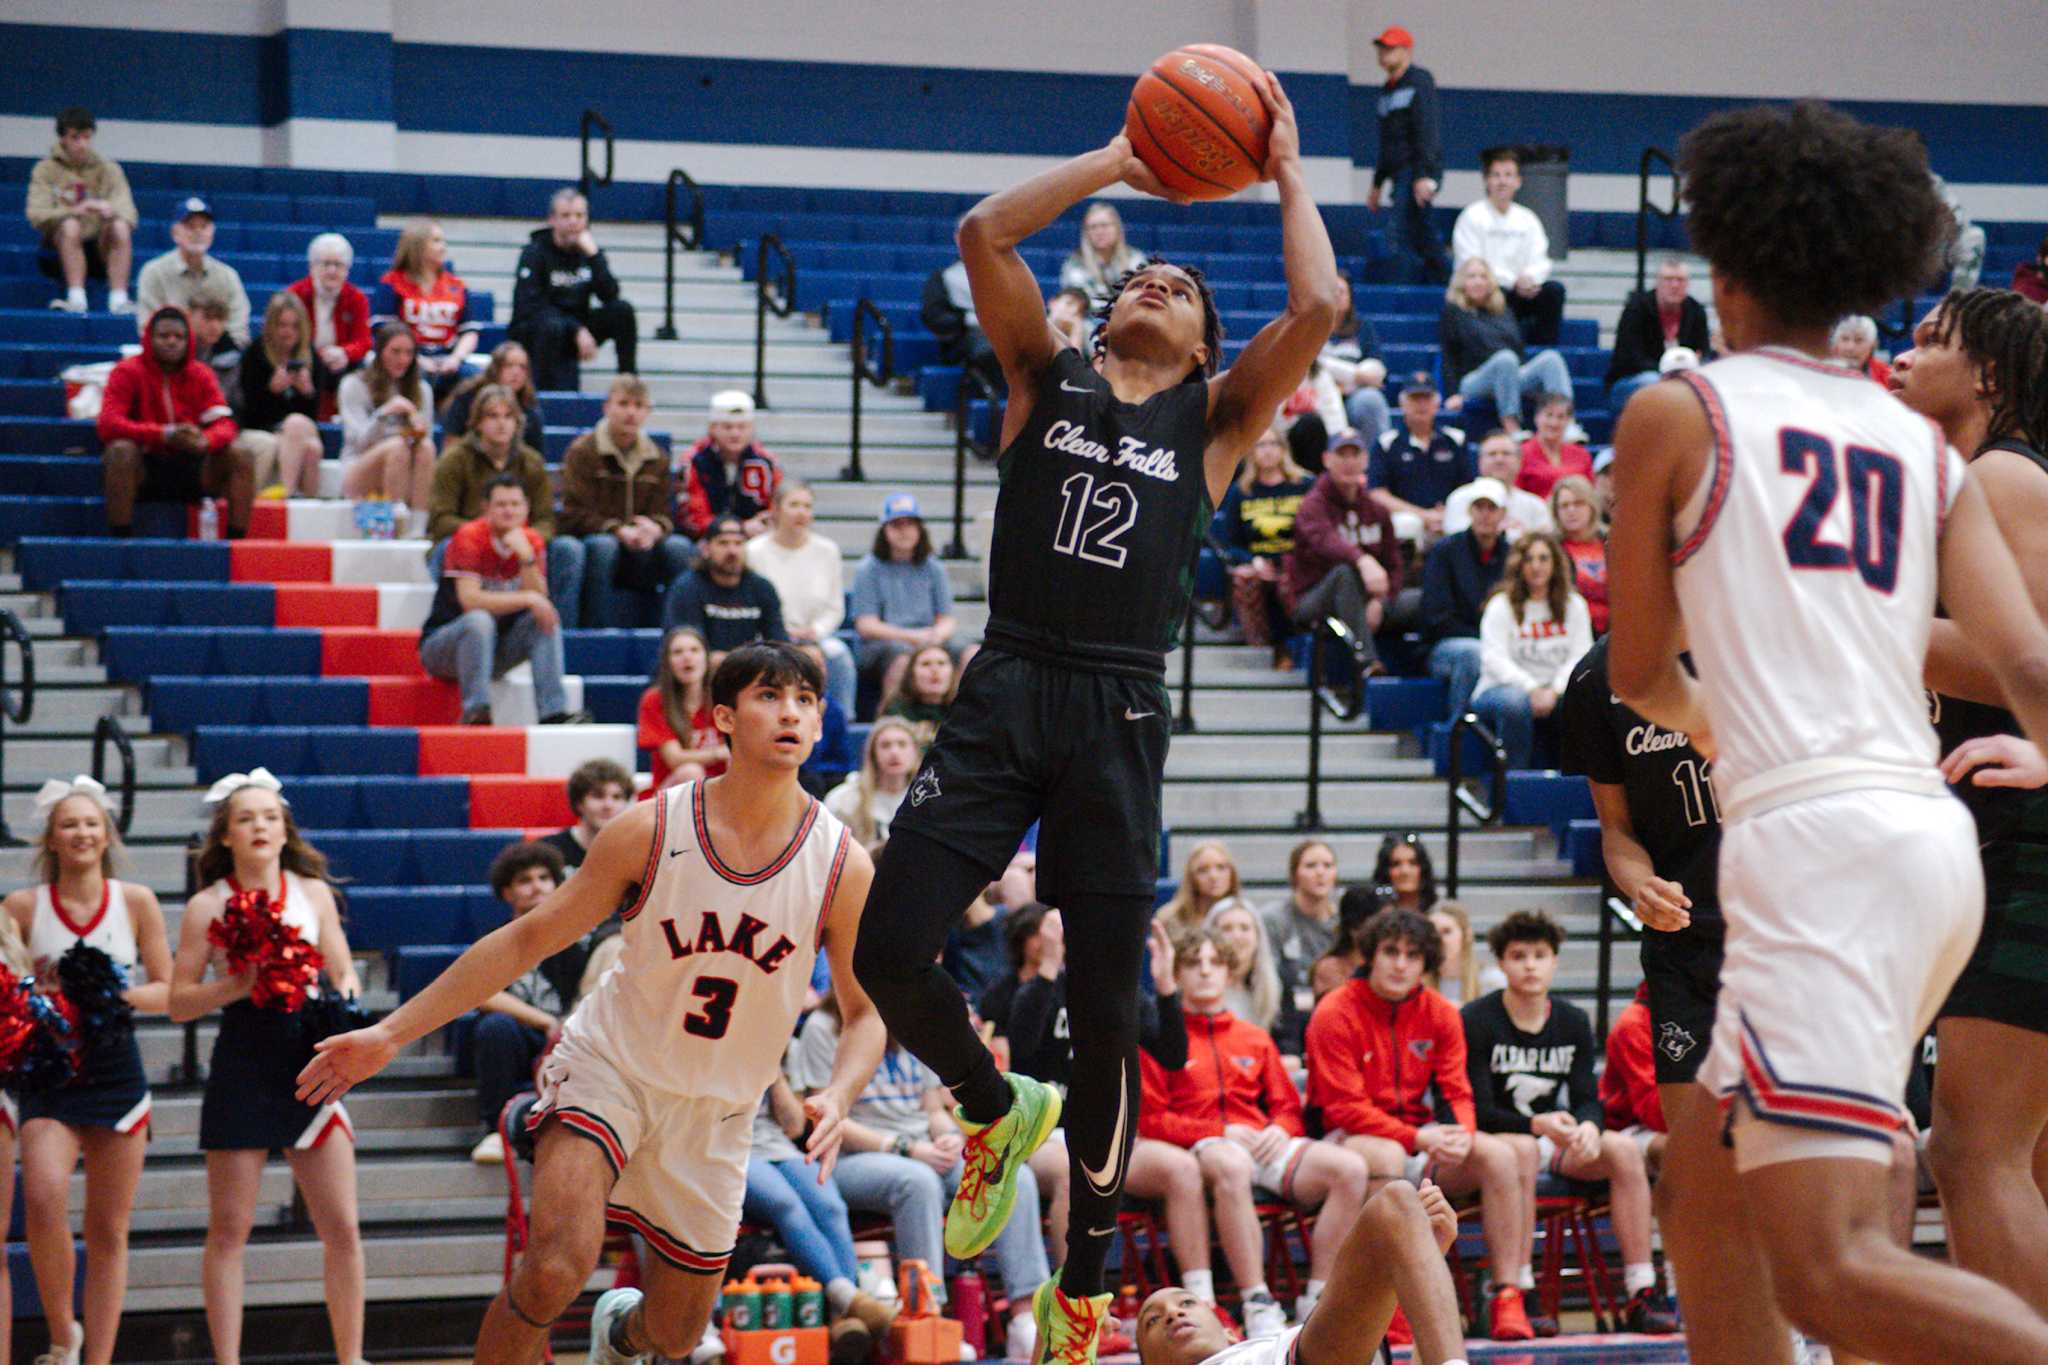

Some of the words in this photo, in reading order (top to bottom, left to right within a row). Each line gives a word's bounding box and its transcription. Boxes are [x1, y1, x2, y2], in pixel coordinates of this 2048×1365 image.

[1043, 419, 1110, 464] Clear
[1112, 435, 1180, 482] Falls
[1053, 471, 1139, 569] 12
[1776, 425, 1905, 598] 20
[1625, 723, 1689, 756] Clear
[659, 910, 797, 975] LAKE
[683, 975, 739, 1040] 3
[769, 1335, 798, 1365] G
